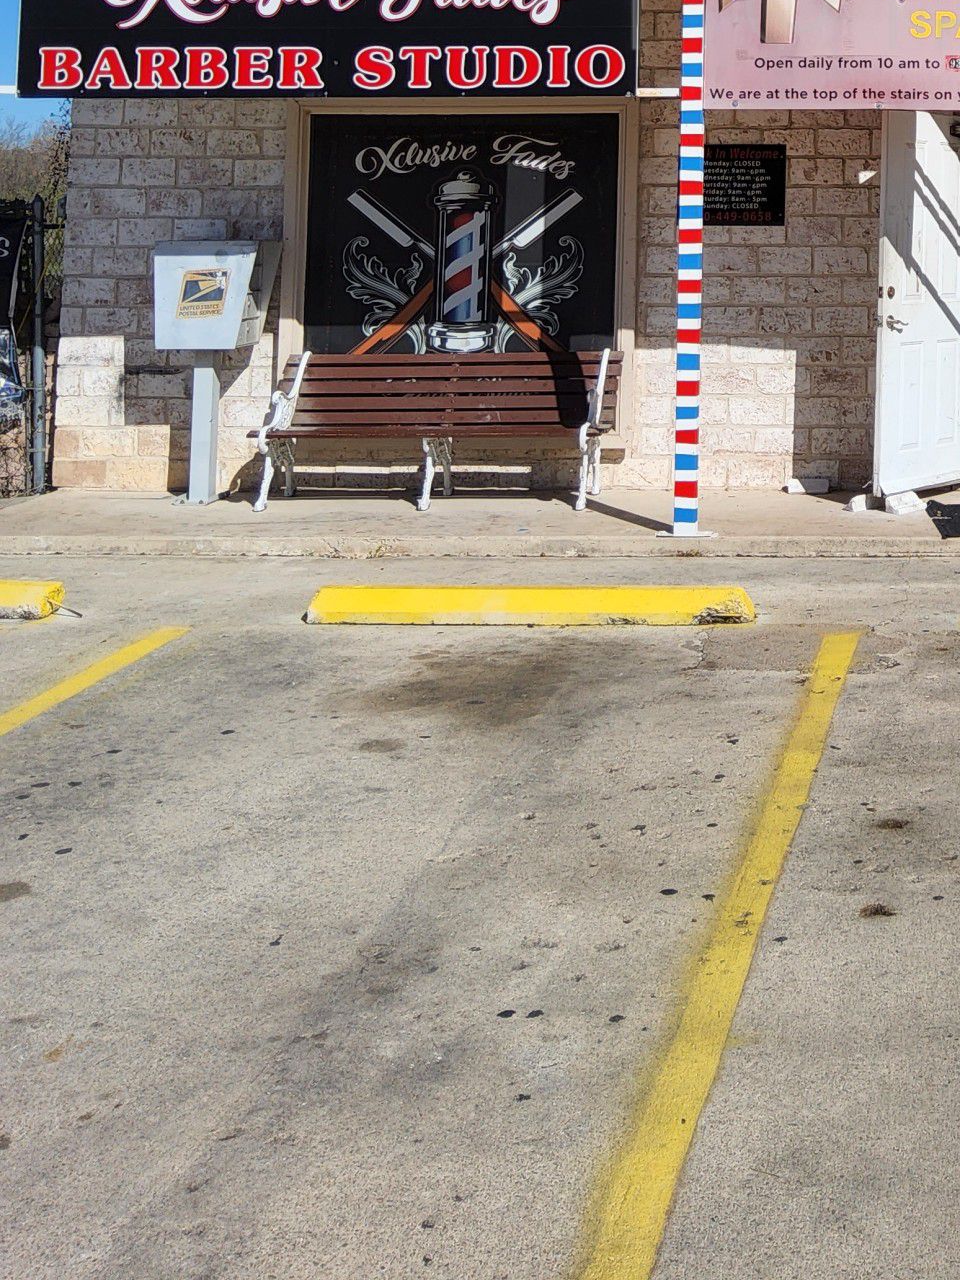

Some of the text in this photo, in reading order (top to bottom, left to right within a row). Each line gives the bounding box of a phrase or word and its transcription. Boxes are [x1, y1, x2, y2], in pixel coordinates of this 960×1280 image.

[36, 43, 627, 90] BARBER STUDIO
[754, 57, 794, 71] Open
[798, 57, 834, 71] daily
[835, 56, 872, 70] from
[877, 57, 894, 70] 10
[898, 60, 920, 70] am
[925, 58, 941, 70] to
[709, 87, 734, 101] We
[737, 91, 761, 101] are
[766, 89, 781, 101] at
[785, 87, 808, 100] the
[812, 89, 838, 103] top
[843, 87, 858, 100] of
[862, 87, 886, 100] the
[890, 87, 930, 101] stairs
[934, 90, 953, 101] on
[490, 134, 576, 180] Fades
[704, 167, 730, 175] uesday:
[704, 211, 772, 222] 0-449-0658
